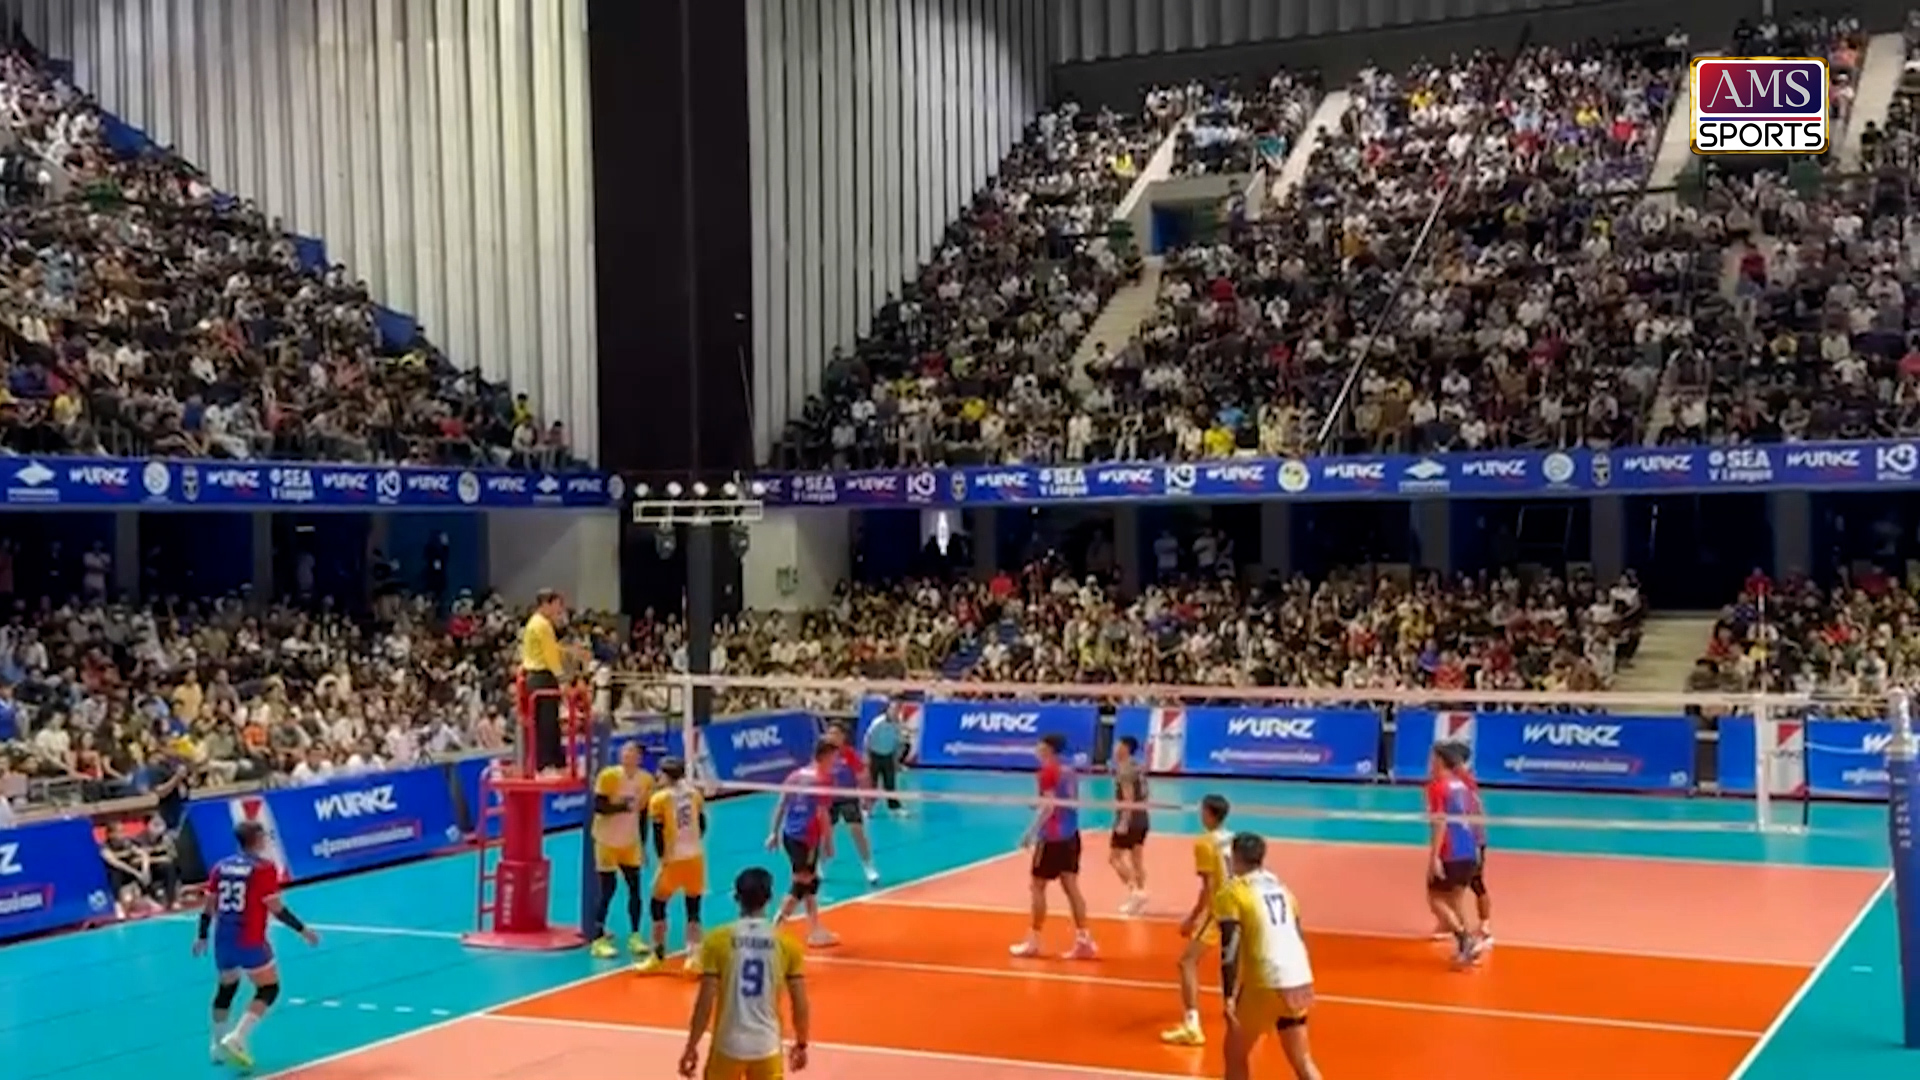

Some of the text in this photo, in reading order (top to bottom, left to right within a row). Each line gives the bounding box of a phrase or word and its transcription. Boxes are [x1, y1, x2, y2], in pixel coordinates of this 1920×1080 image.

[1727, 449, 1771, 468] SEA
[283, 469, 312, 487] SEA
[805, 475, 835, 491] SEA
[1055, 468, 1086, 485] SEA
[960, 712, 1040, 733] WURKZ
[1228, 717, 1316, 739] WURKZ
[1522, 723, 1623, 746] WURKZ
[314, 784, 397, 821] WURKZ
[218, 880, 246, 912] 23
[1264, 892, 1287, 925] 17
[741, 959, 764, 997] 9
